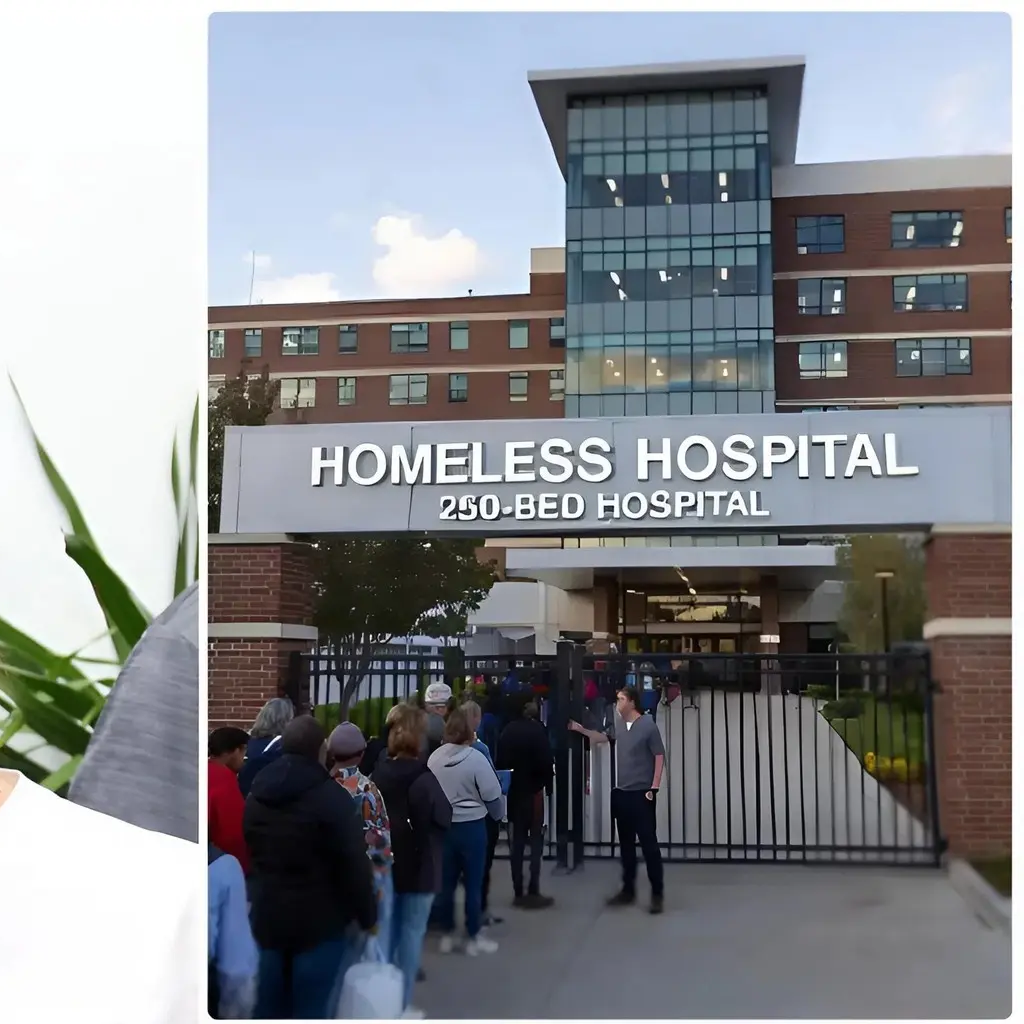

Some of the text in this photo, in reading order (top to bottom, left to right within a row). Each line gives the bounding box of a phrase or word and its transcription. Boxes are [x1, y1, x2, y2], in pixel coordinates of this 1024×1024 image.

[310, 432, 920, 487] HOMELESS HOSPITAL
[597, 489, 770, 520] HOSPITAL
